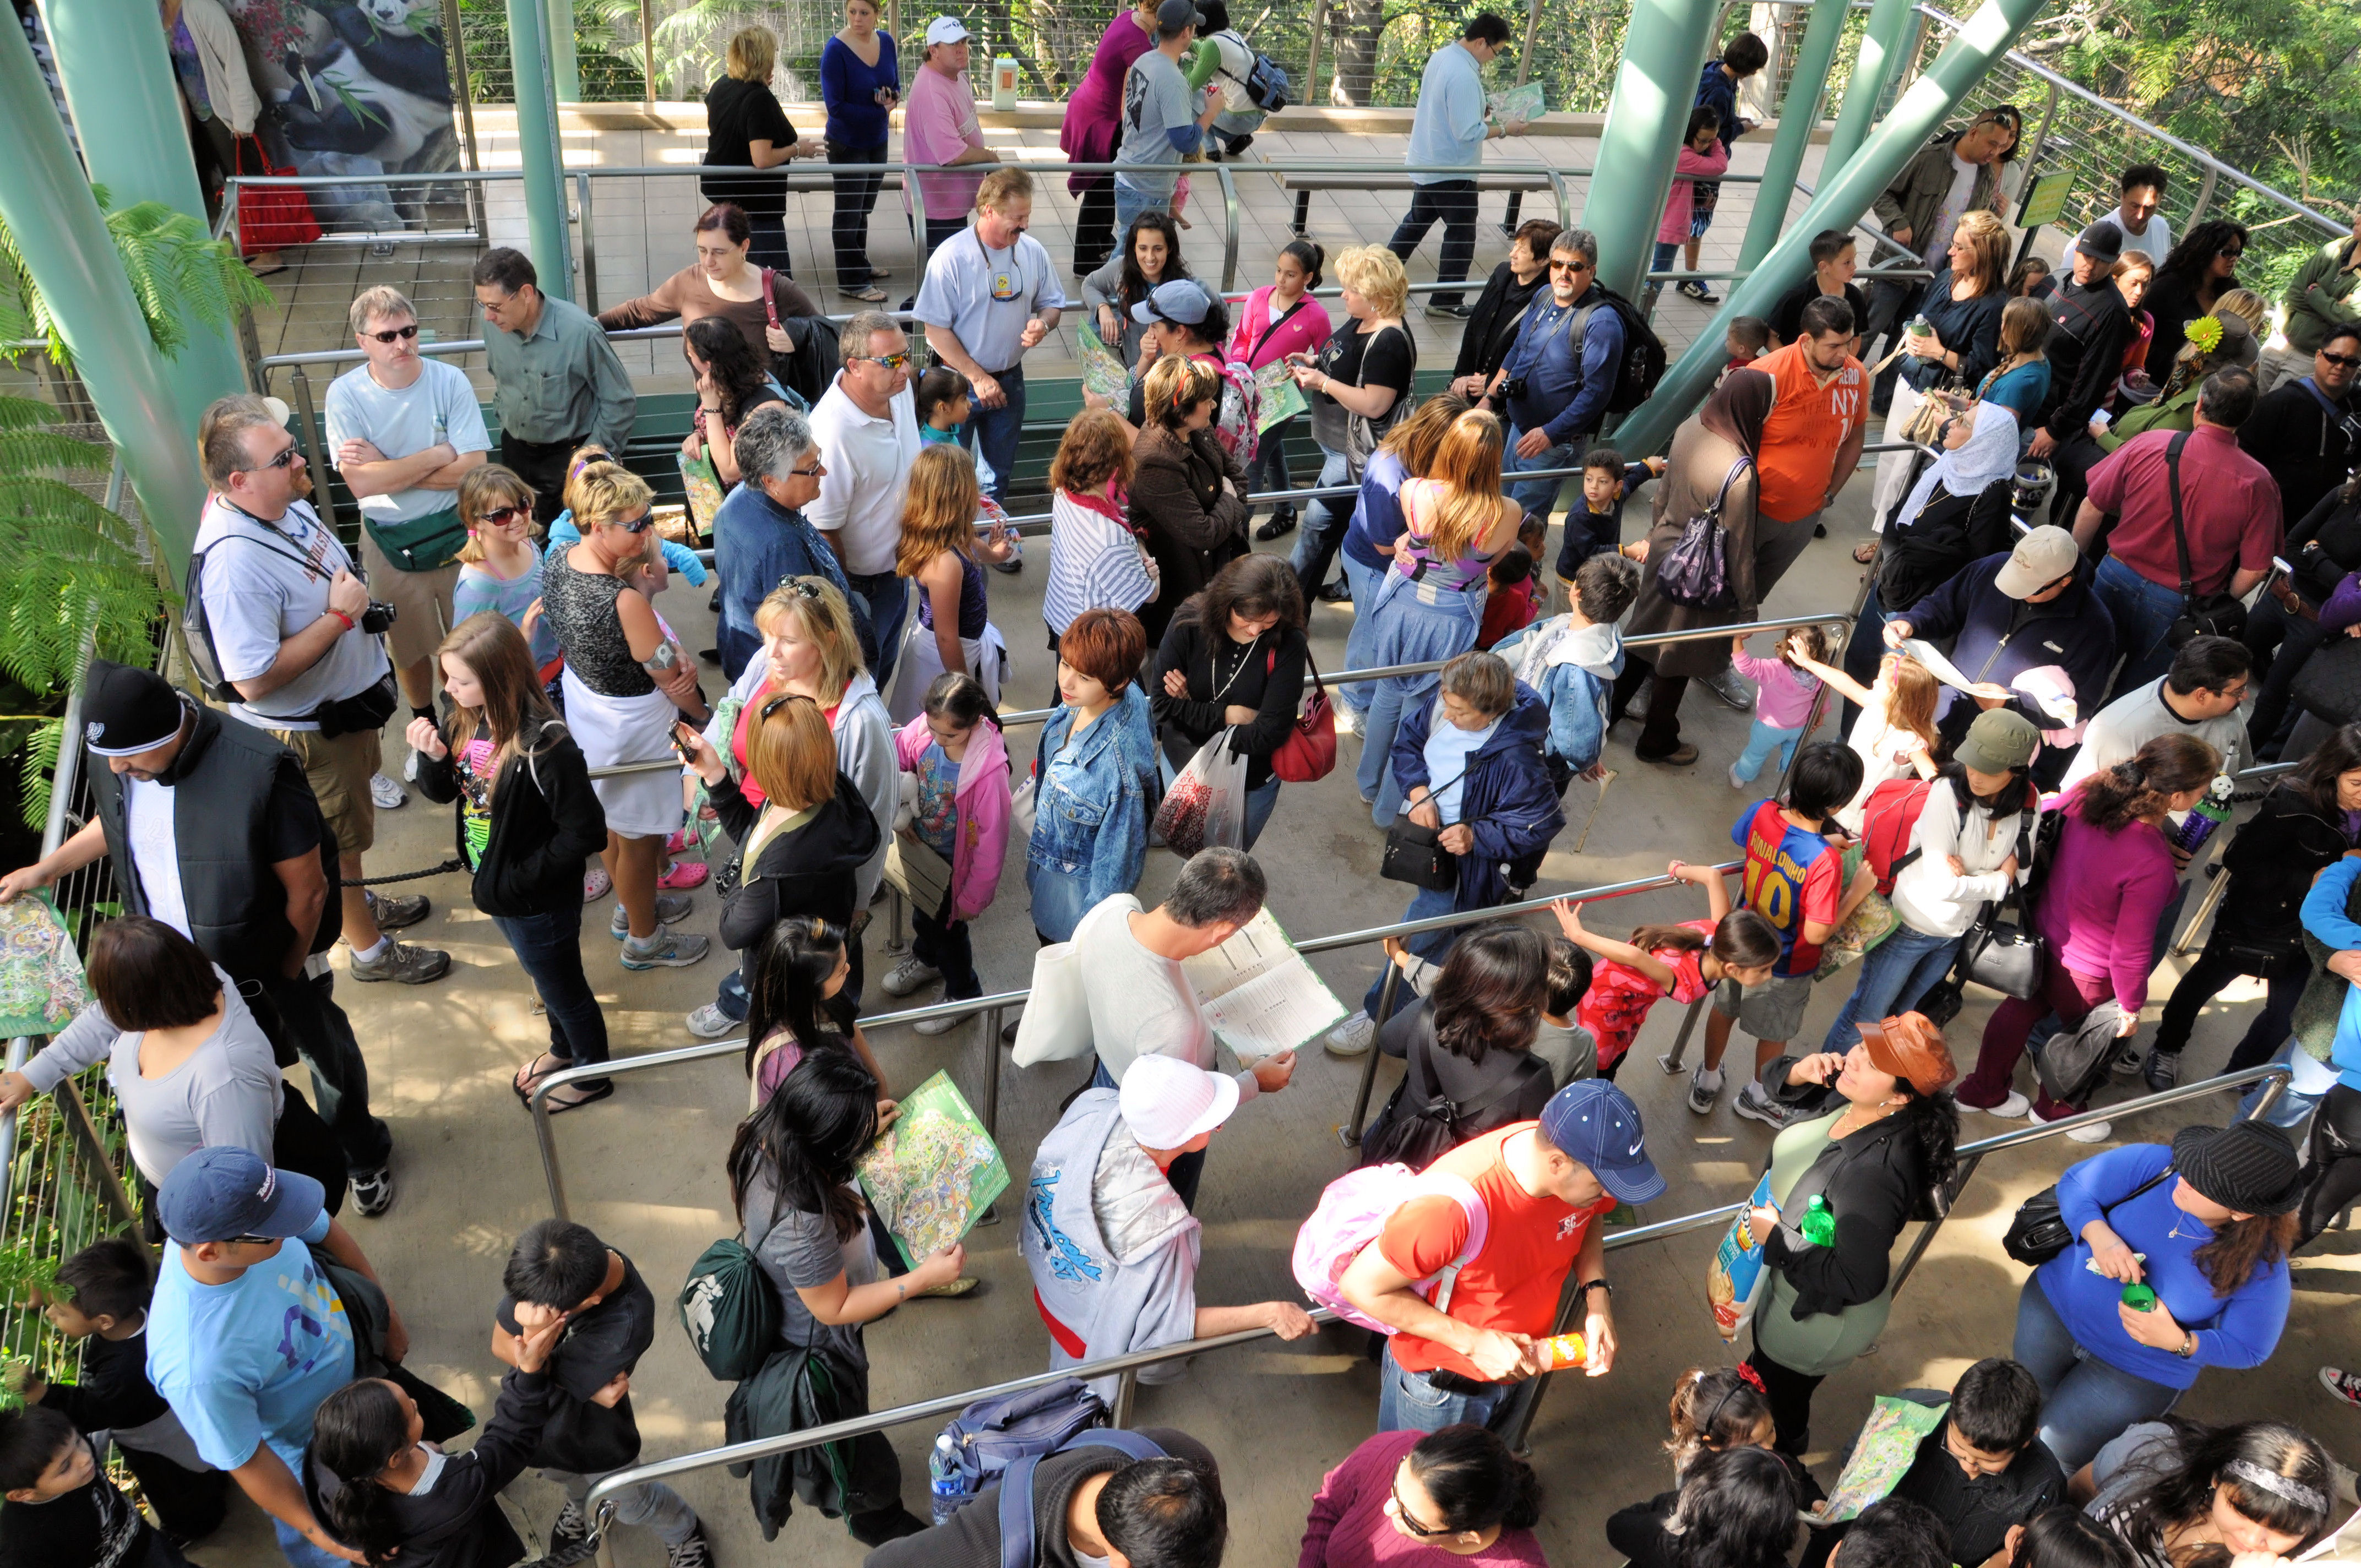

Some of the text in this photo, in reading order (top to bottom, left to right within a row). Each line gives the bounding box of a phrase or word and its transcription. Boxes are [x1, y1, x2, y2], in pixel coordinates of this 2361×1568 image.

[1838, 368, 1859, 385] AERO
[1832, 388, 1859, 416] NY
[1745, 857, 1792, 929] 10
